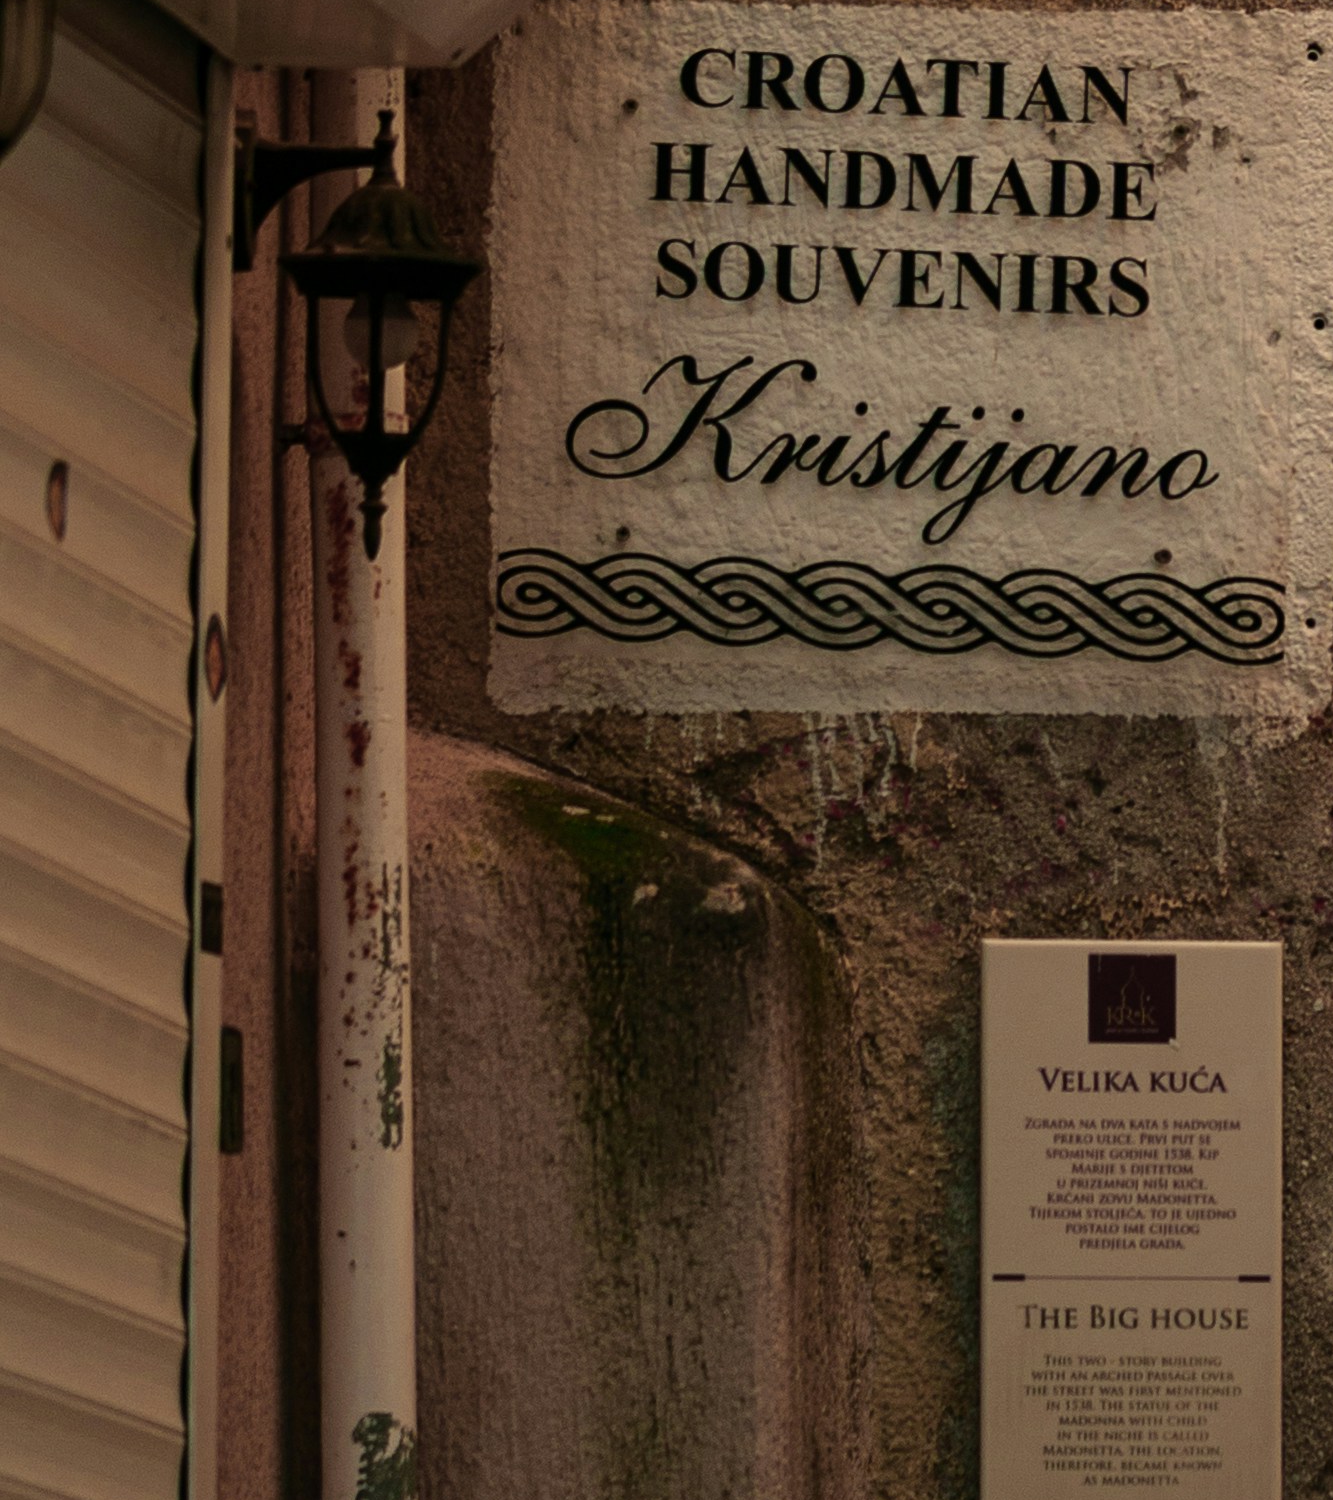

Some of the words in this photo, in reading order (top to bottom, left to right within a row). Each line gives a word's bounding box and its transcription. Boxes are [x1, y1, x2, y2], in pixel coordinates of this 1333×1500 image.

[678, 48, 1135, 127] CROATIAN
[649, 141, 1158, 222] HANDMADE
[655, 238, 1152, 318] SOUVENIRS
[565, 354, 1219, 546] Kristijano
[1038, 1066, 1140, 1093] VELIKA
[1149, 1064, 1228, 1093] KUĆA
[1079, 1117, 1096, 1130] NA
[1101, 1117, 1125, 1130] DVA
[1129, 1117, 1158, 1130] KATA
[1173, 1117, 1241, 1130] NADVOJEM
[1053, 1133, 1093, 1145] PREKO
[1172, 1133, 1194, 1145] PUT
[1198, 1133, 1211, 1145] SE
[1045, 1148, 1105, 1161] SPOMINJE
[1109, 1148, 1159, 1161] GODINE
[1130, 1163, 1193, 1175] DJETETOM
[1056, 1178, 1066, 1190] U
[1070, 1178, 1139, 1190] PRIZEMNOJ
[1098, 1192, 1133, 1205] ZOVU
[1150, 1207, 1167, 1220] TO
[1171, 1207, 1182, 1220] JE
[1186, 1207, 1237, 1220] UJEDNO
[1065, 1223, 1119, 1235] POSTALO
[1124, 1223, 1145, 1235] IME
[1149, 1223, 1200, 1235] CIJELOG
[1079, 1238, 1136, 1250] PREDJELA
[1020, 1304, 1078, 1330] THE
[1089, 1304, 1139, 1330] BIG
[1150, 1306, 1250, 1330] HOUSE
[1078, 1354, 1106, 1367] TWO
[1031, 1370, 1065, 1382] WITH
[1070, 1370, 1088, 1382] AN
[1091, 1370, 1143, 1382] ARCHED
[1147, 1370, 1197, 1382] PASSAGE
[1201, 1370, 1234, 1382] OVER
[1024, 1384, 1047, 1397] THE
[1052, 1384, 1094, 1397] STREET
[1099, 1384, 1124, 1397] WAS
[1128, 1384, 1161, 1397] FIRST
[1165, 1384, 1242, 1397] MENTIONED
[1046, 1399, 1060, 1412] IN
[1128, 1399, 1171, 1412] STATUE
[1174, 1399, 1191, 1412] OF
[1197, 1399, 1218, 1412] THE
[1128, 1415, 1163, 1426] WITH
[1057, 1430, 1071, 1441] IN
[1076, 1430, 1099, 1441] THE
[1104, 1430, 1143, 1441] NICHE
[1148, 1430, 1158, 1441] IS
[1129, 1445, 1152, 1456] THE
[1121, 1460, 1168, 1471] BECAME
[1083, 1475, 1098, 1486] AS
